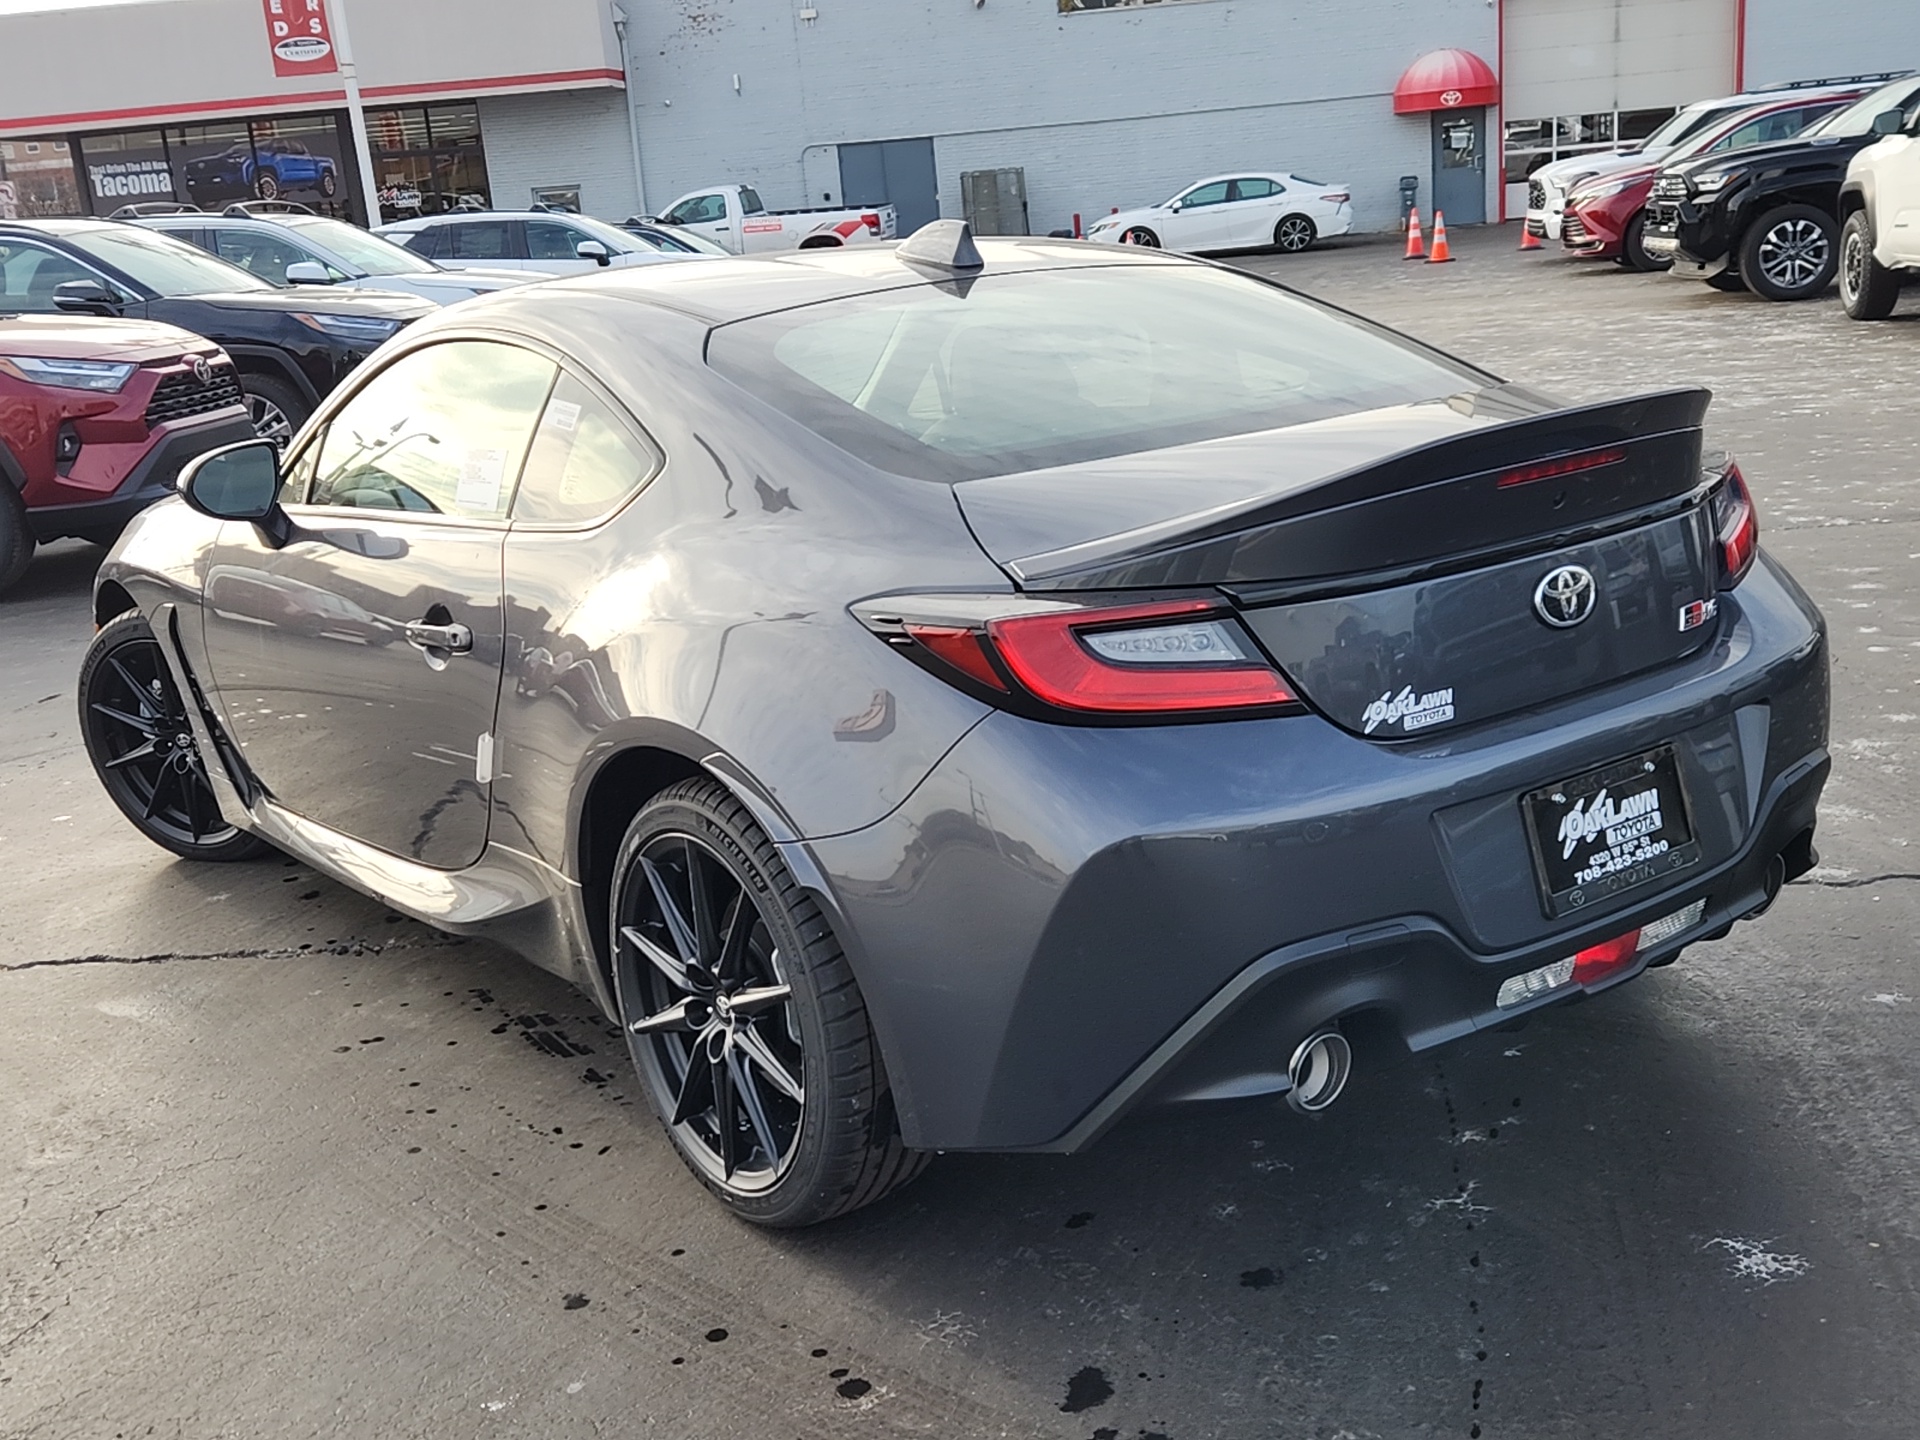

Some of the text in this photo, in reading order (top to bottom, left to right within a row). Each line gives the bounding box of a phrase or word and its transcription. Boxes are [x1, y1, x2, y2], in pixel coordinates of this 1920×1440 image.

[90, 172, 172, 197] Tacoma
[1411, 708, 1447, 725] TOYOTA
[1613, 815, 1657, 841] TOYOTA
[709, 824, 764, 889] MICHELIN
[1574, 839, 1669, 885] 708-423-5200
[1589, 850, 1611, 866] 4320
[1611, 846, 1621, 857] W
[1602, 862, 1656, 893] TOYOTA
